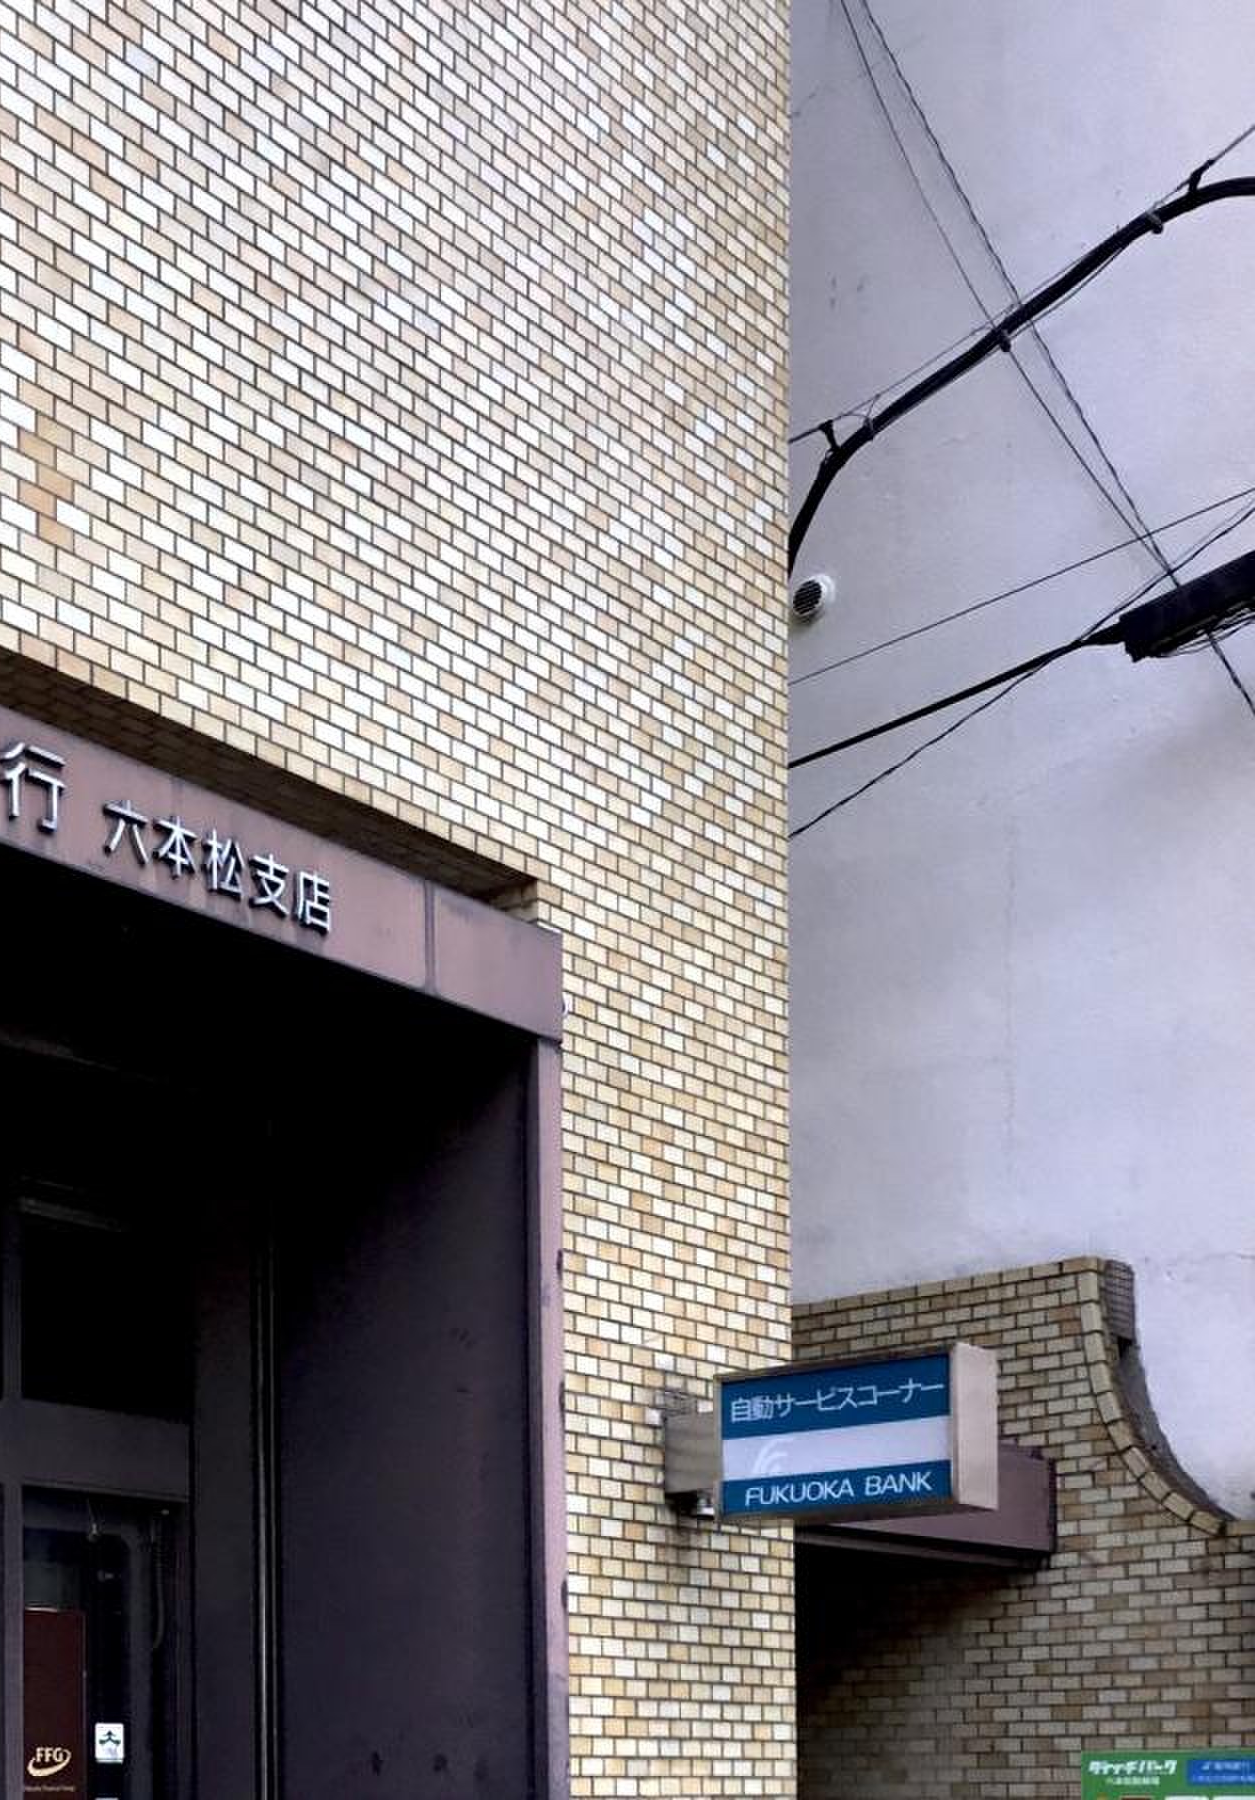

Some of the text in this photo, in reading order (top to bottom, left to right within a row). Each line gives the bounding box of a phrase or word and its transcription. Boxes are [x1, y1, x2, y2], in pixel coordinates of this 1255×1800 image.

[103, 800, 332, 935] 六本松支店
[730, 1378, 944, 1423] 自動サービスコーナー
[745, 1471, 933, 1506] FUKUOKA BANK
[36, 1747, 64, 1763] FFG
